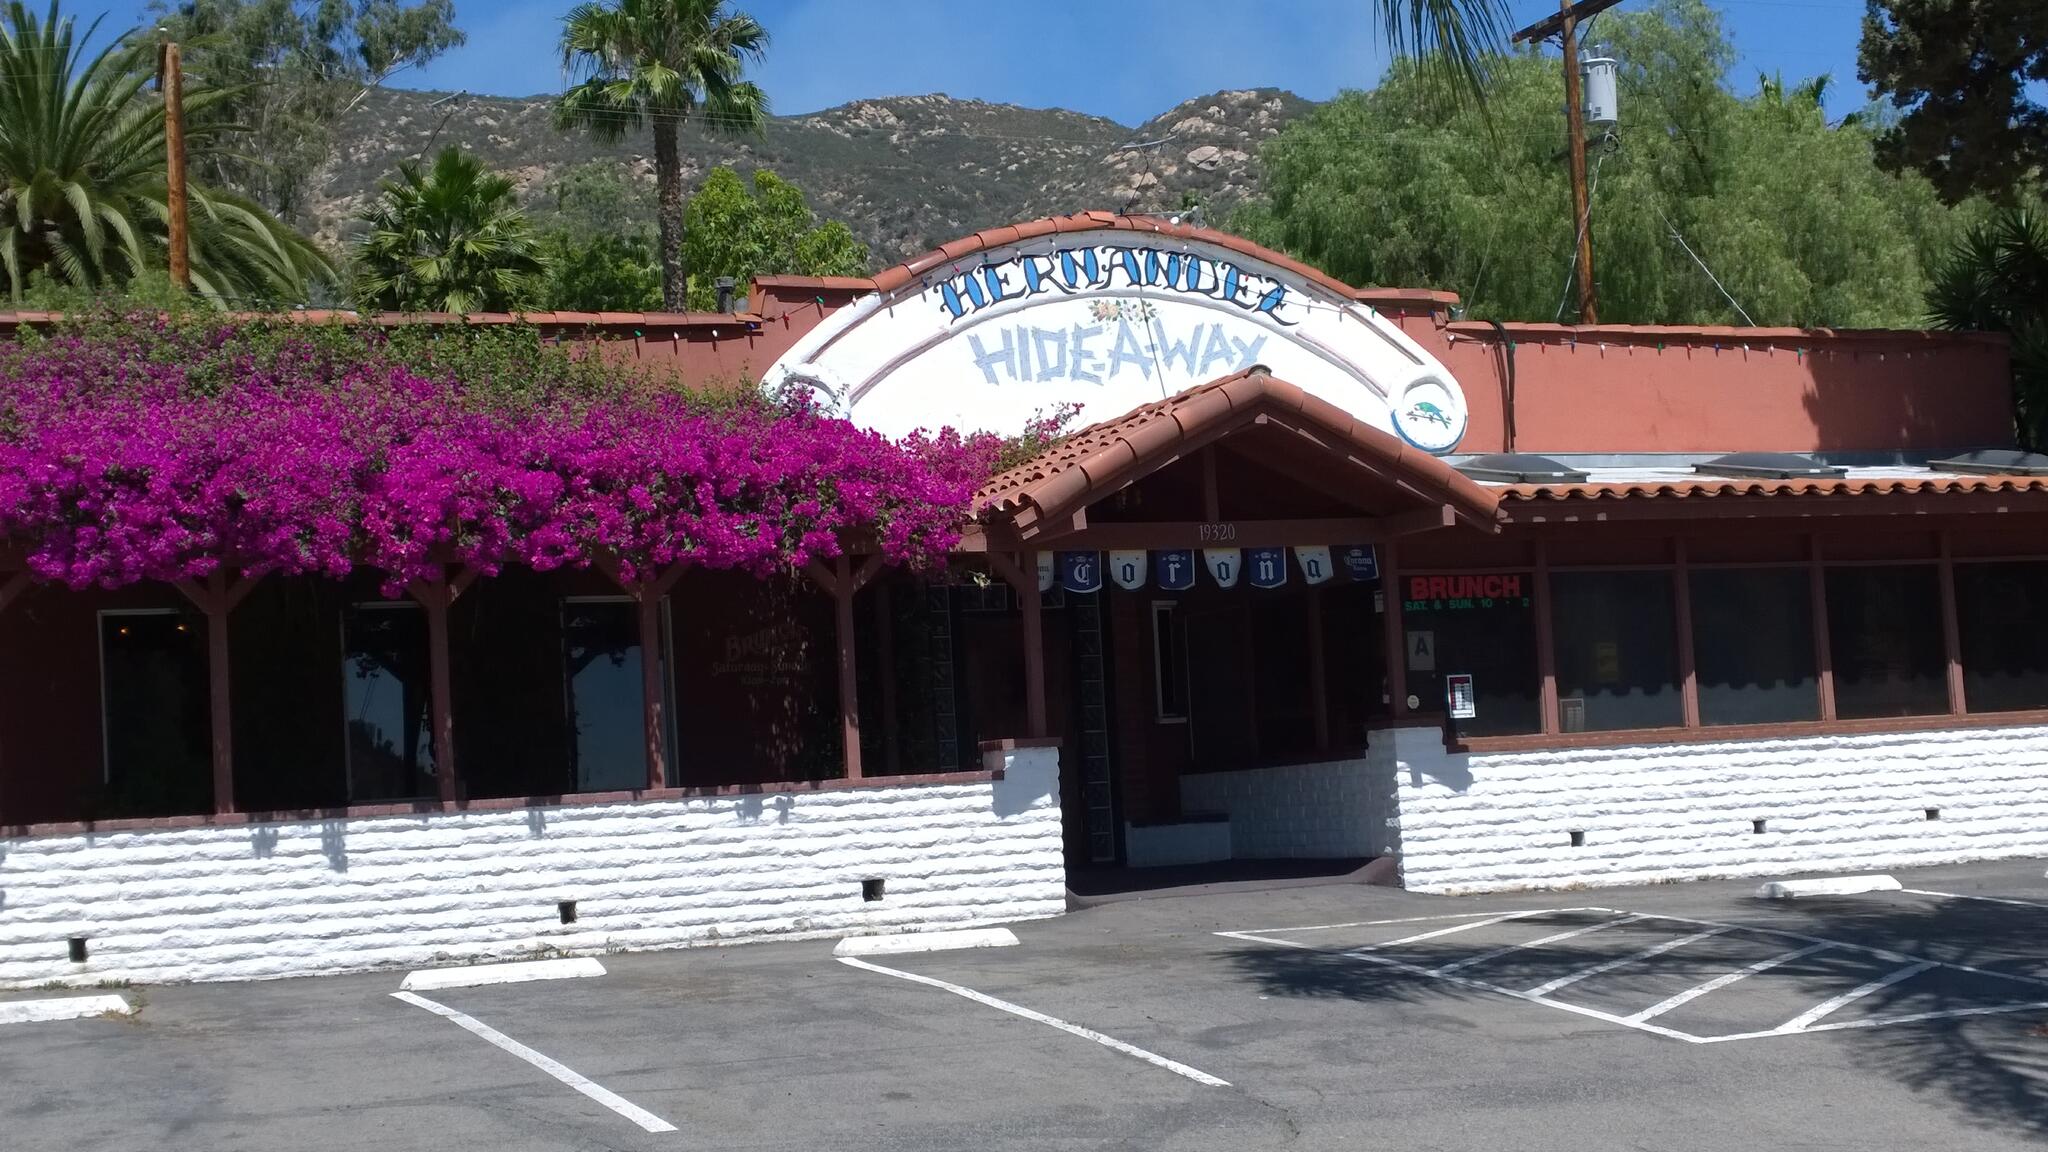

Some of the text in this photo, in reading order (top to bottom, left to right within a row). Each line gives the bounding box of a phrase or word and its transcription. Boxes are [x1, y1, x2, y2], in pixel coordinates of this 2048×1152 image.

[933, 246, 1299, 325] HERNANDEZ
[1199, 523, 1236, 541] 19320
[1410, 575, 1520, 600] BRUNCH
[1415, 636, 1429, 656] A
